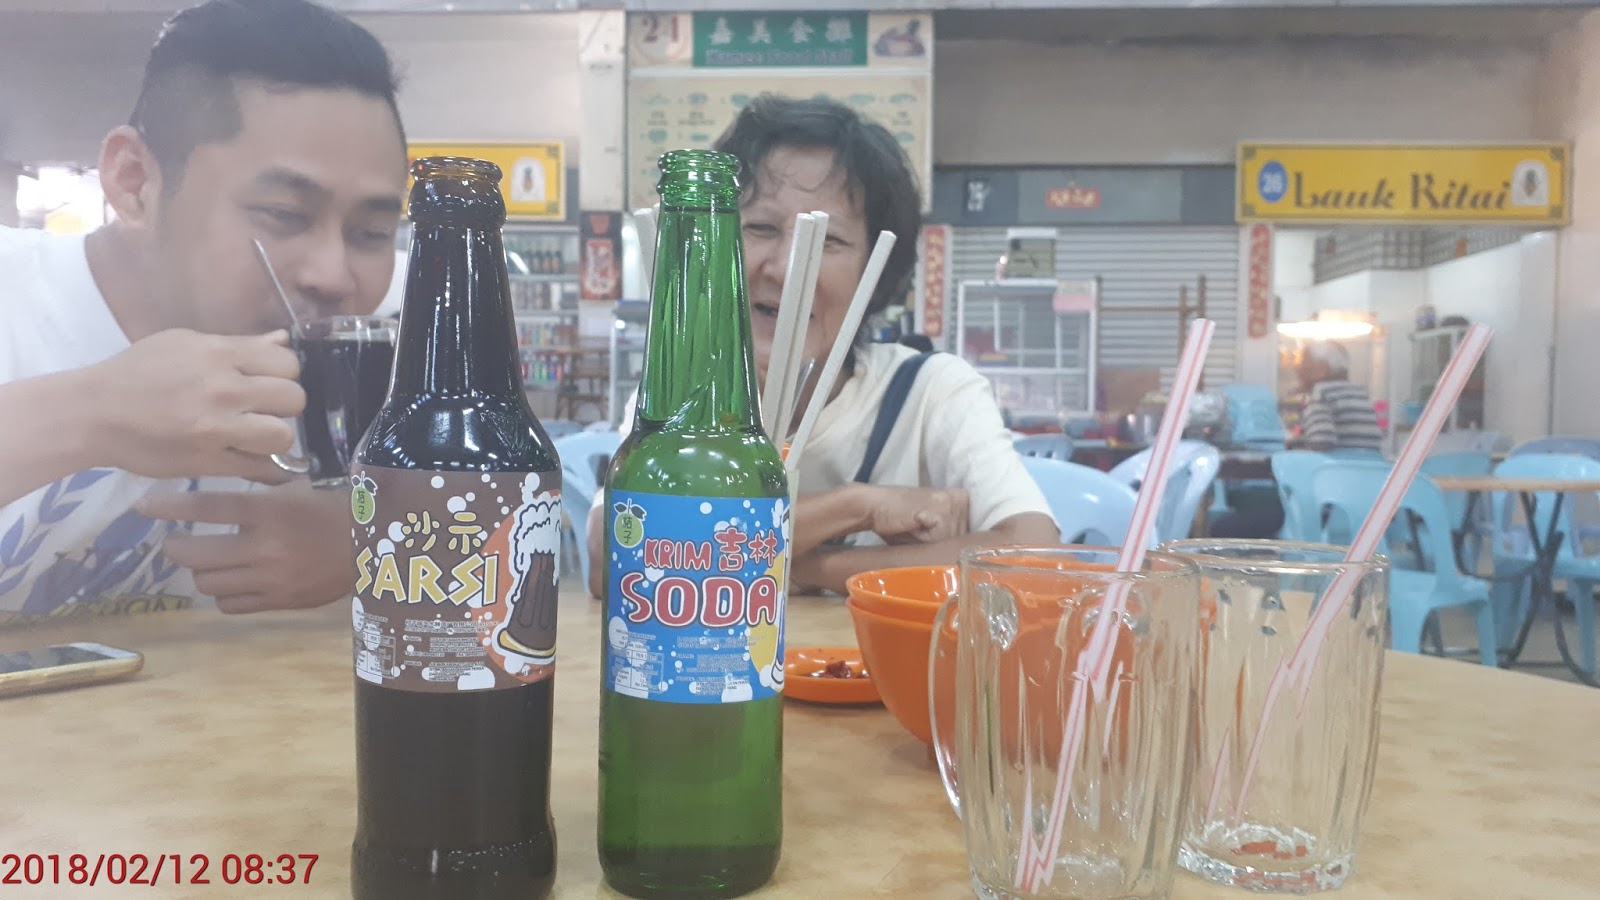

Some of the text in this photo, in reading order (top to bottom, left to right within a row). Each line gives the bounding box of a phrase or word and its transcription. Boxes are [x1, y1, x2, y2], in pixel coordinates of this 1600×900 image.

[401, 510, 483, 555] 沙示
[643, 526, 778, 572] KRIM 吉林
[355, 546, 499, 606] SARSI
[620, 571, 778, 628] SODA
